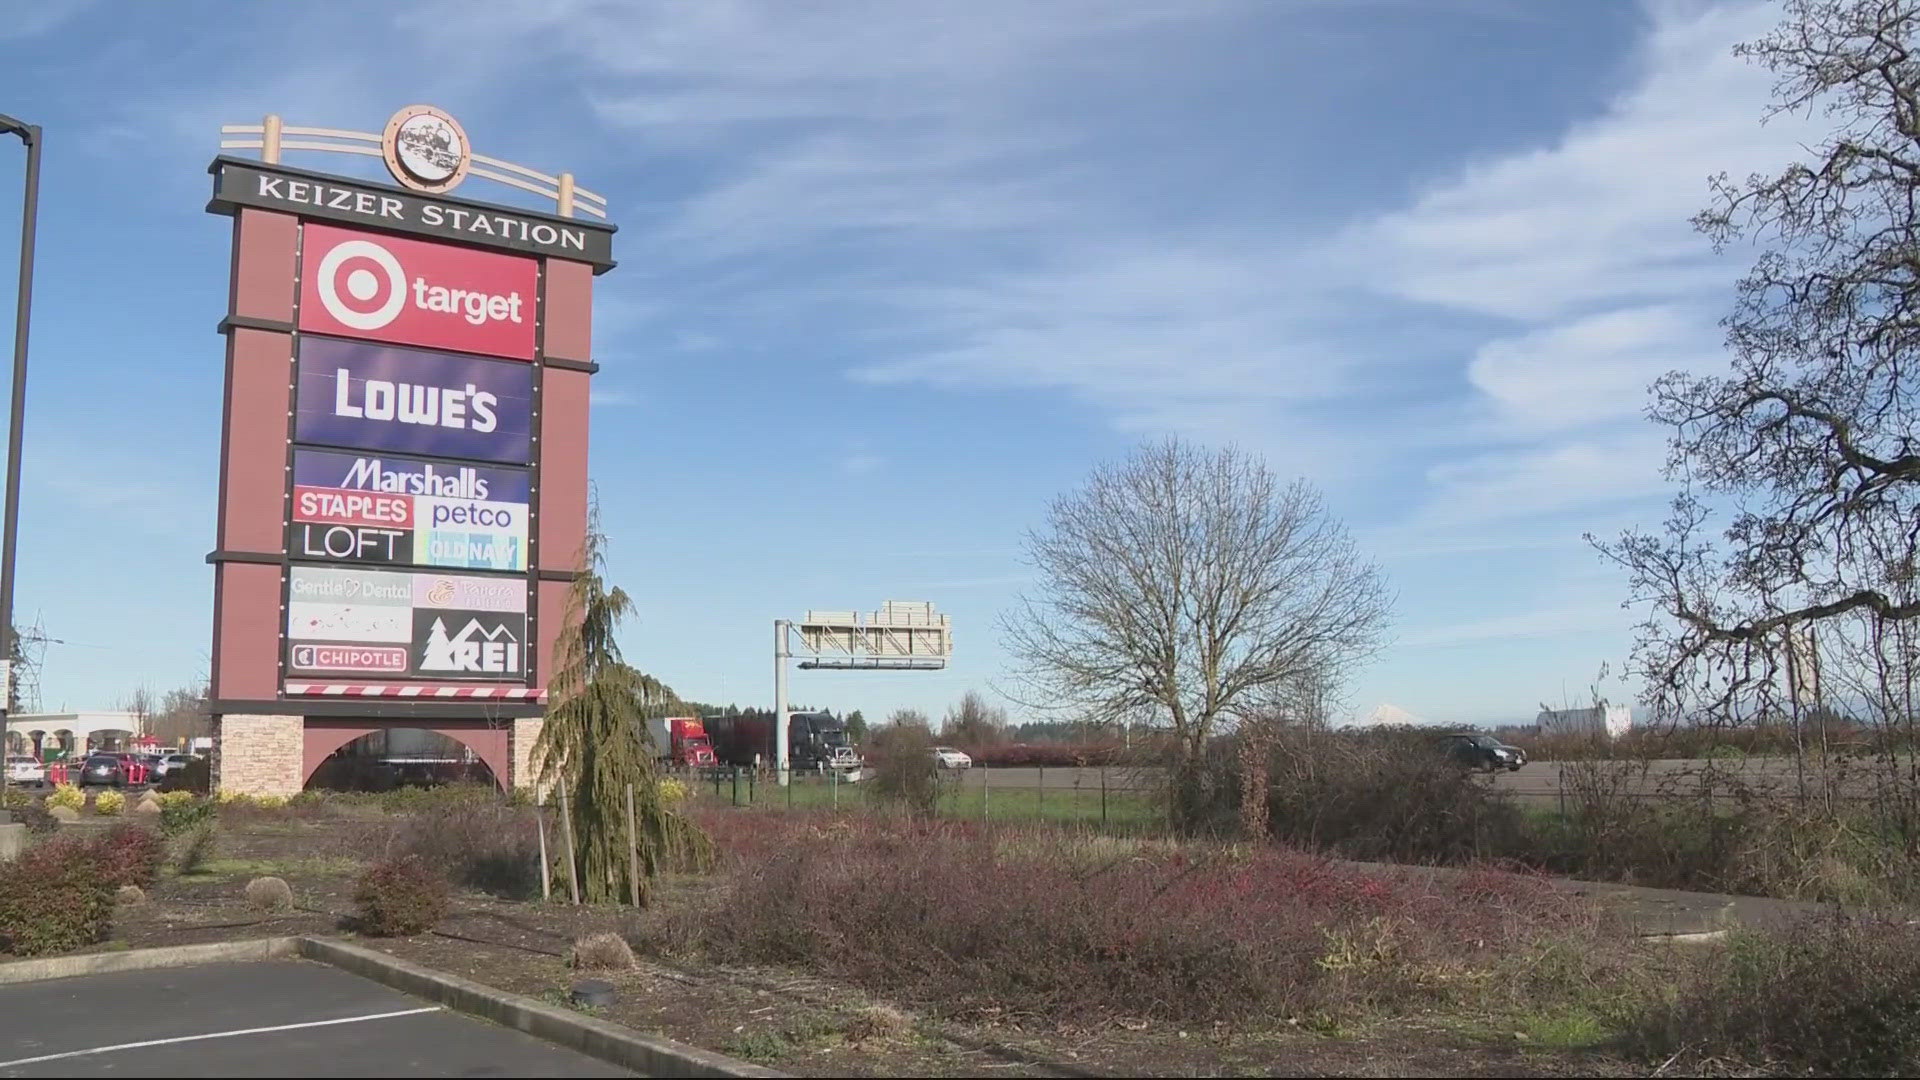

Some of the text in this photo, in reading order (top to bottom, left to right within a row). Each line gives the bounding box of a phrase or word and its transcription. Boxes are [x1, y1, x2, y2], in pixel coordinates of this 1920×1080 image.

[258, 175, 585, 251] KEIZER STATION
[412, 277, 522, 325] target
[335, 368, 498, 433] LOWE'S
[341, 458, 489, 500] Marshalls
[300, 492, 407, 522] STAPLES
[433, 503, 511, 528] petco
[304, 525, 404, 560] LOFT
[430, 539, 516, 563] OLD NAVY
[292, 577, 411, 600] Gentle Dental
[318, 650, 403, 667] CHIPOTLE
[460, 641, 518, 673] REI
